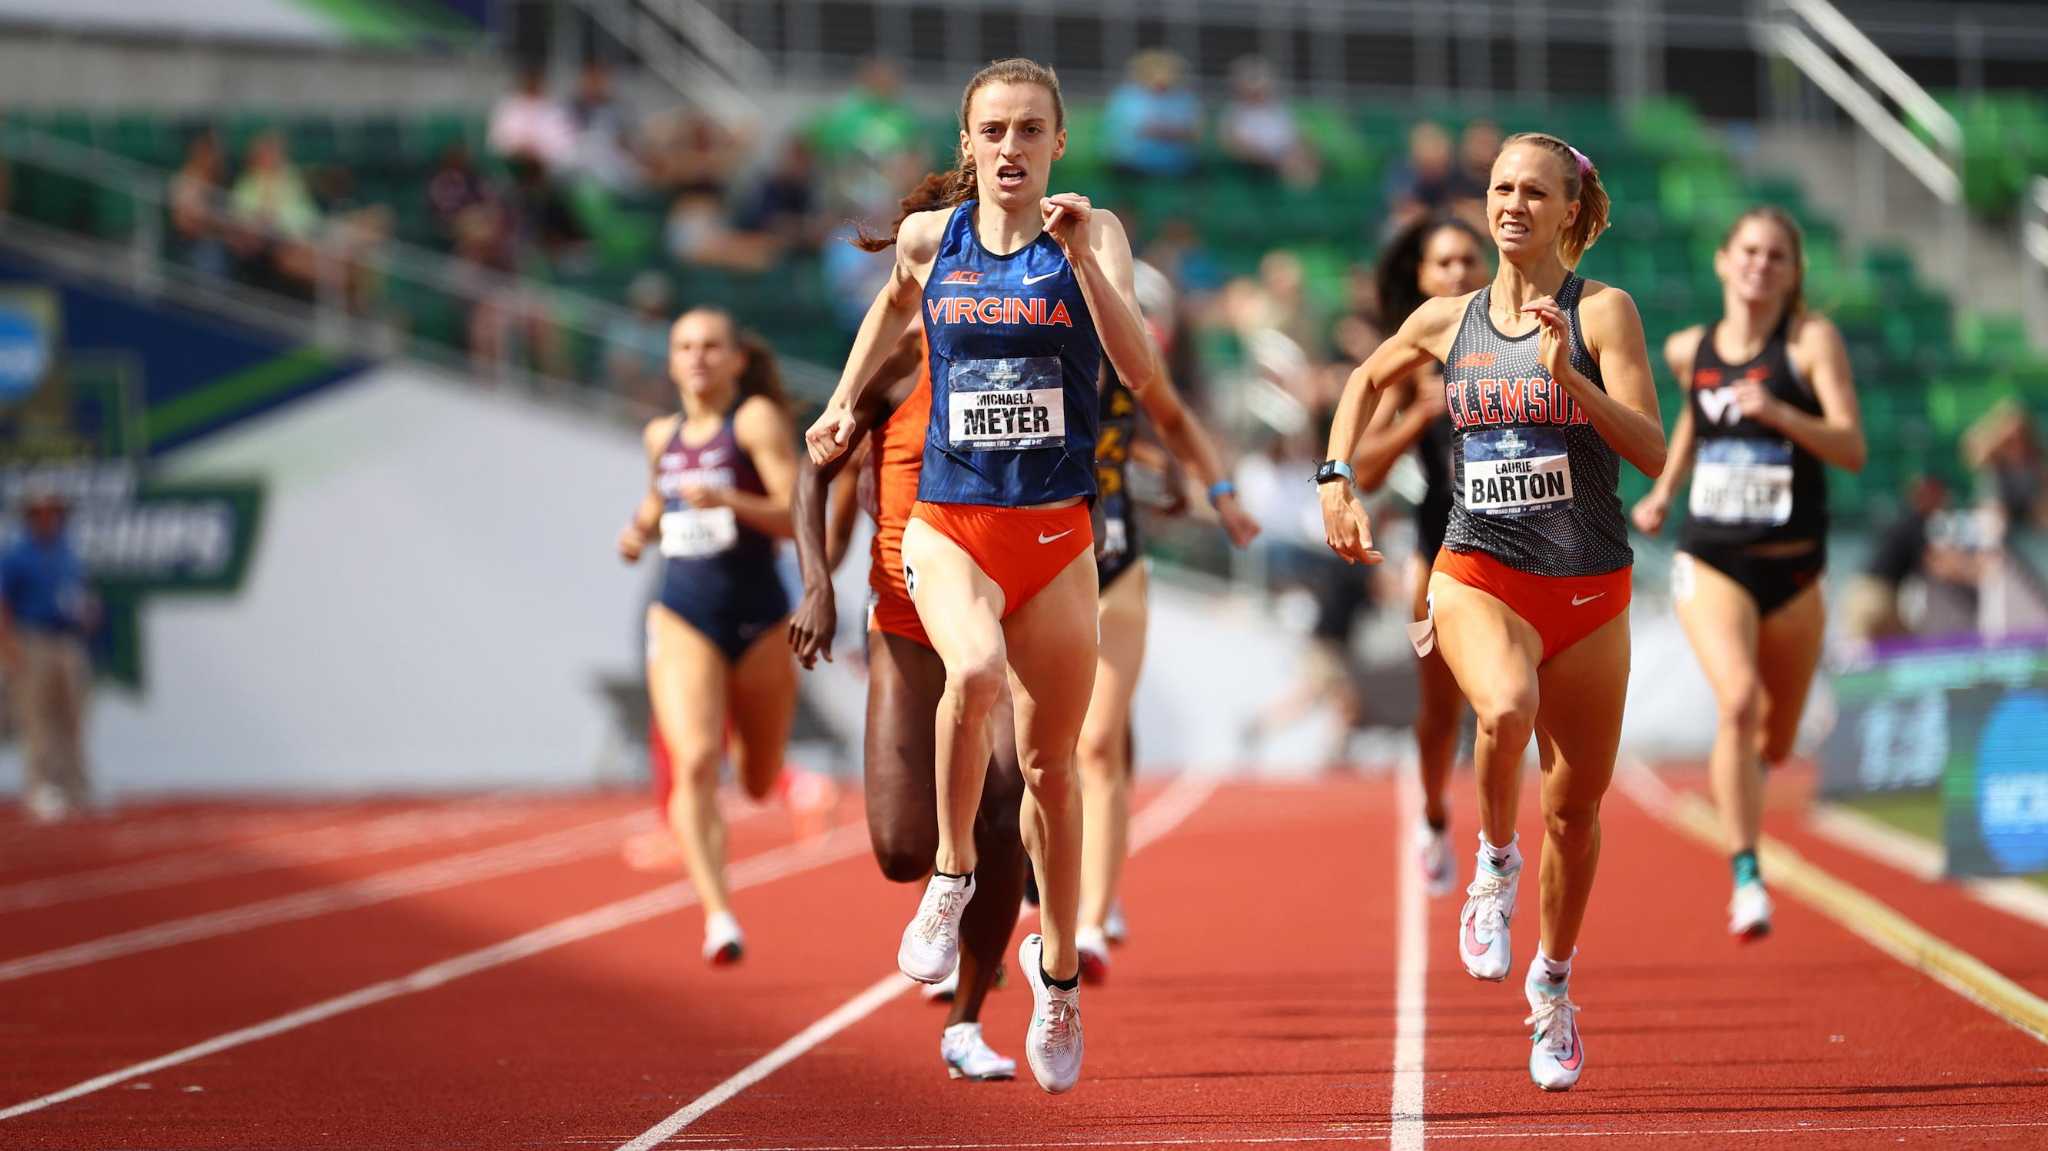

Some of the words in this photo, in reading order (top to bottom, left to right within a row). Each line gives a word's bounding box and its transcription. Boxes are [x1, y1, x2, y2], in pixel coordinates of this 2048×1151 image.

[943, 270, 985, 283] ACC
[927, 297, 1073, 328] VIRGINIA
[976, 393, 1034, 406] MICHAELA
[964, 406, 1050, 435] MEYER
[1495, 461, 1533, 474] LAURIE
[1472, 471, 1566, 503] BARTON
